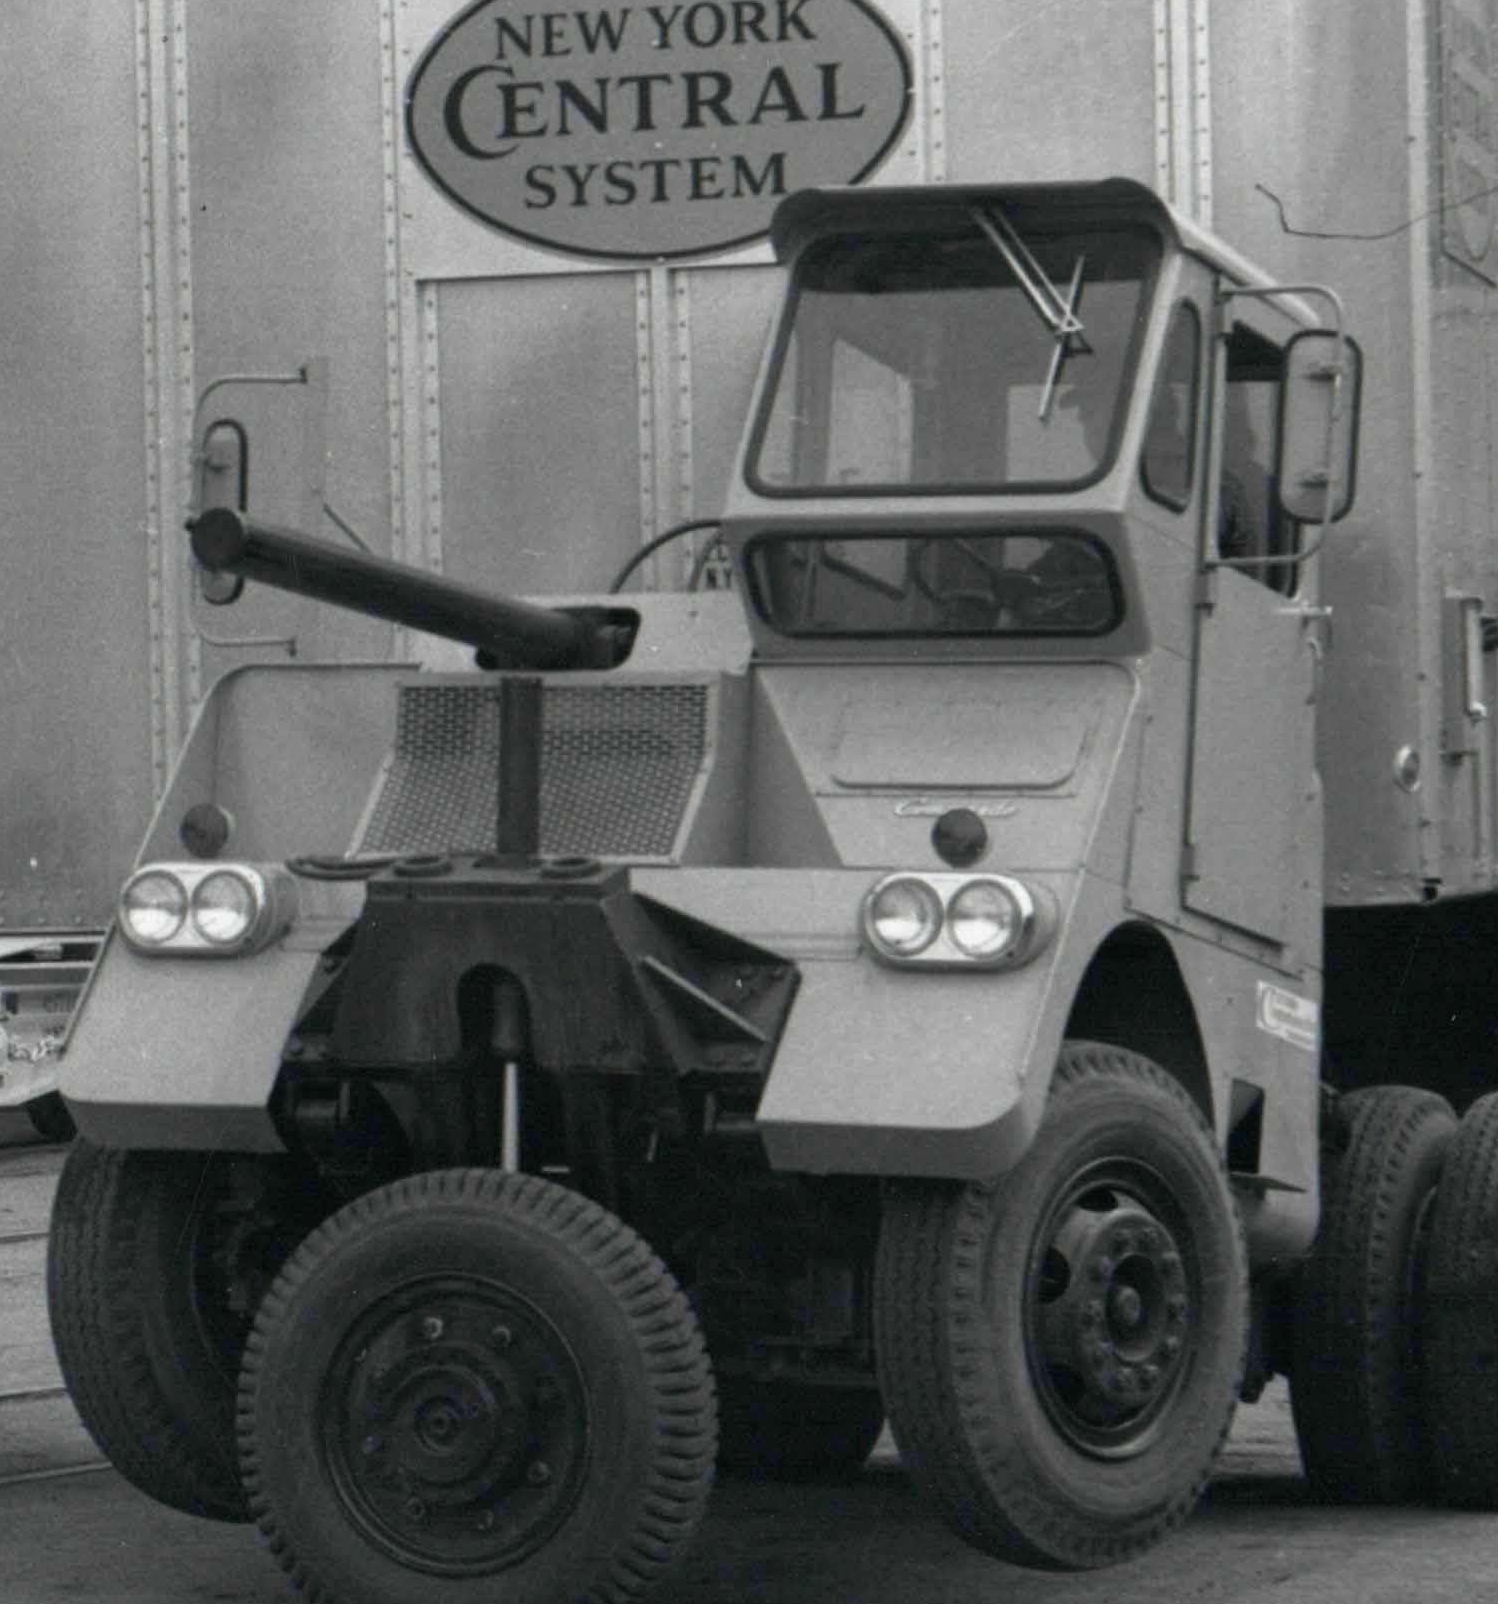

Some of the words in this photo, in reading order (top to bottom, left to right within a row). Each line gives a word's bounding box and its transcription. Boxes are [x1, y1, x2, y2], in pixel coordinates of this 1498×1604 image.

[495, 8, 631, 60] NEW
[443, 62, 867, 161] CENTRAL
[524, 152, 787, 209] SYSTEM
